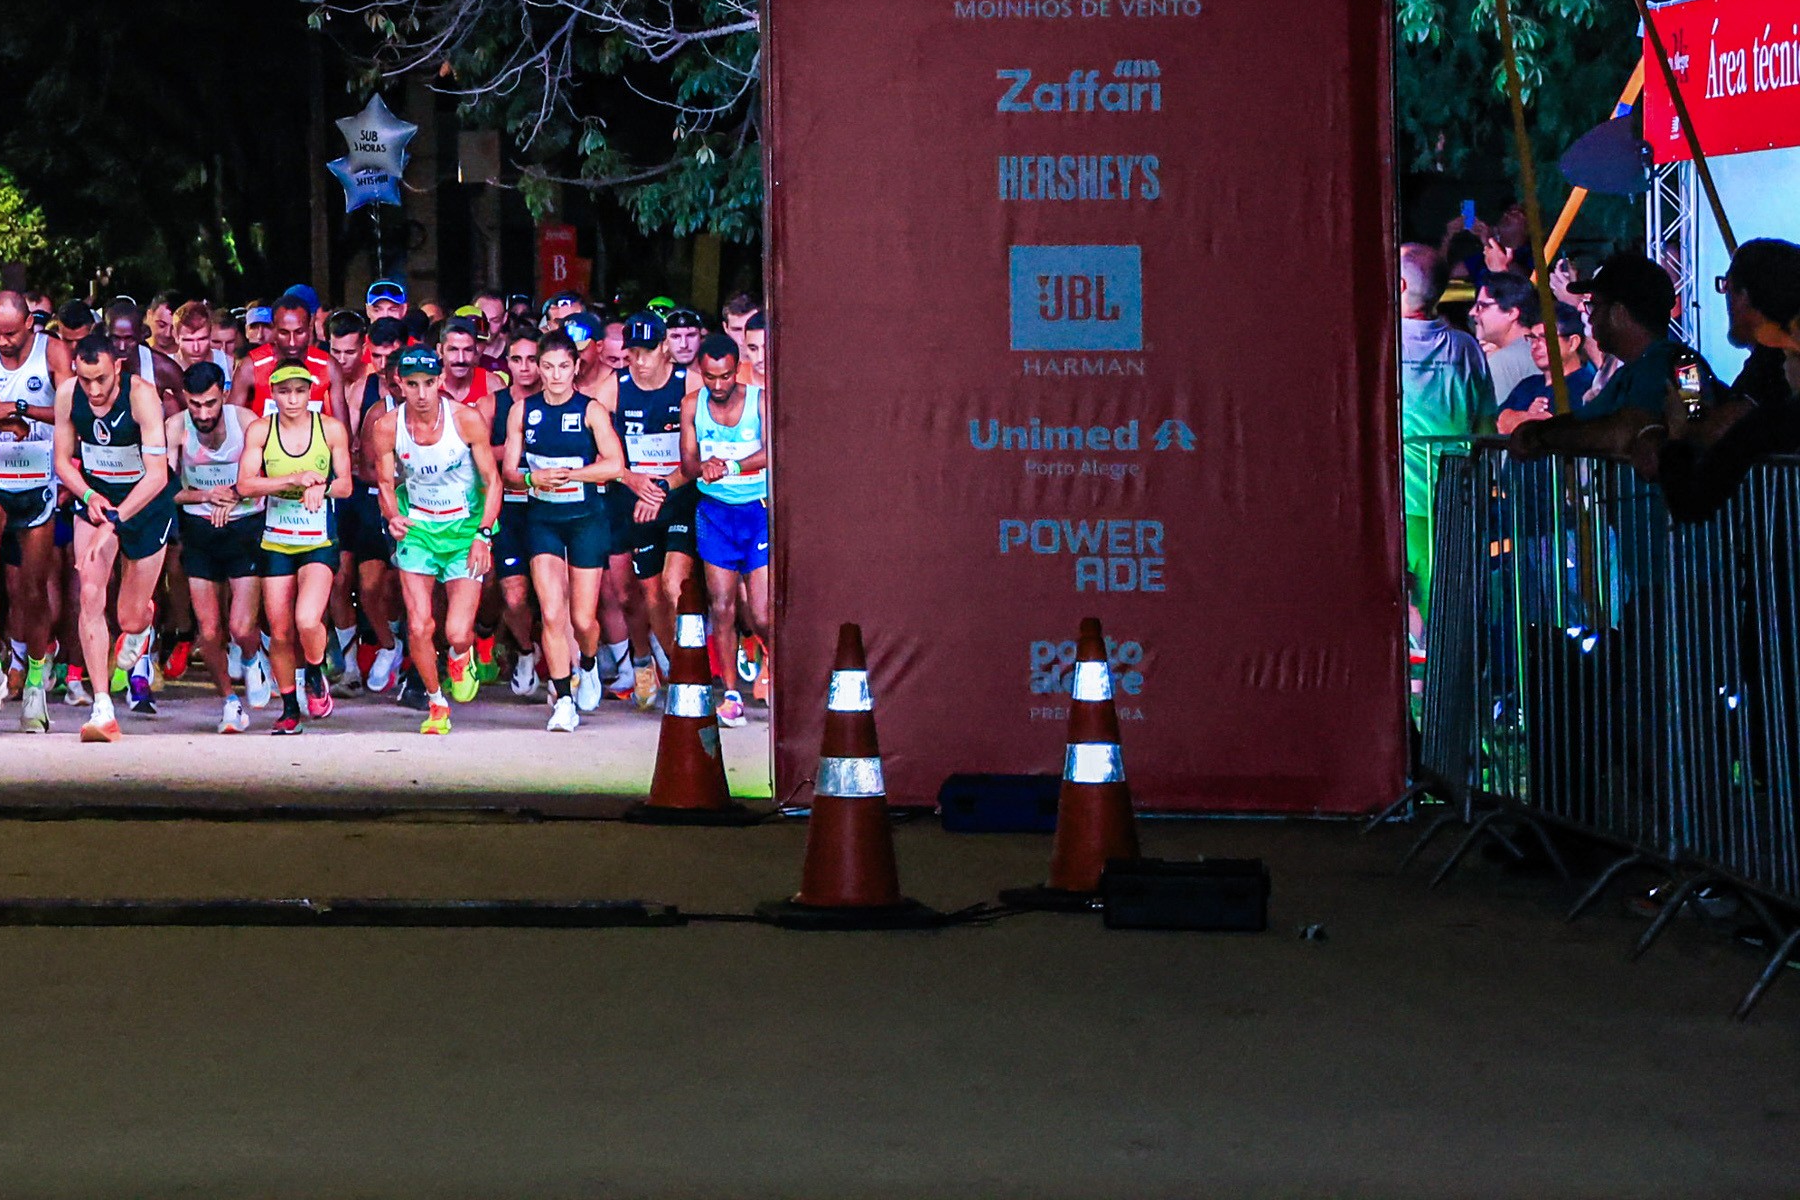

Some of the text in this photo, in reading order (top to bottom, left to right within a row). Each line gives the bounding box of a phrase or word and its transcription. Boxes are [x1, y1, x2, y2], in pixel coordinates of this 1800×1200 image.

[953, 0, 1073, 19] MOINHOS
[1081, 0, 1111, 17] DE
[1704, 17, 1748, 99] Área
[997, 62, 1162, 112] Zaffari
[360, 130, 378, 142] SUB
[998, 155, 1161, 201] HERSHEY'S
[1038, 275, 1121, 322] JBL
[1023, 357, 1145, 377] HARMAN
[968, 418, 1140, 451] Unimed
[1025, 459, 1140, 481] Porto Alegre
[999, 519, 1165, 555] POWER
[1076, 557, 1166, 593] ADE
[1030, 637, 1143, 670] poto
